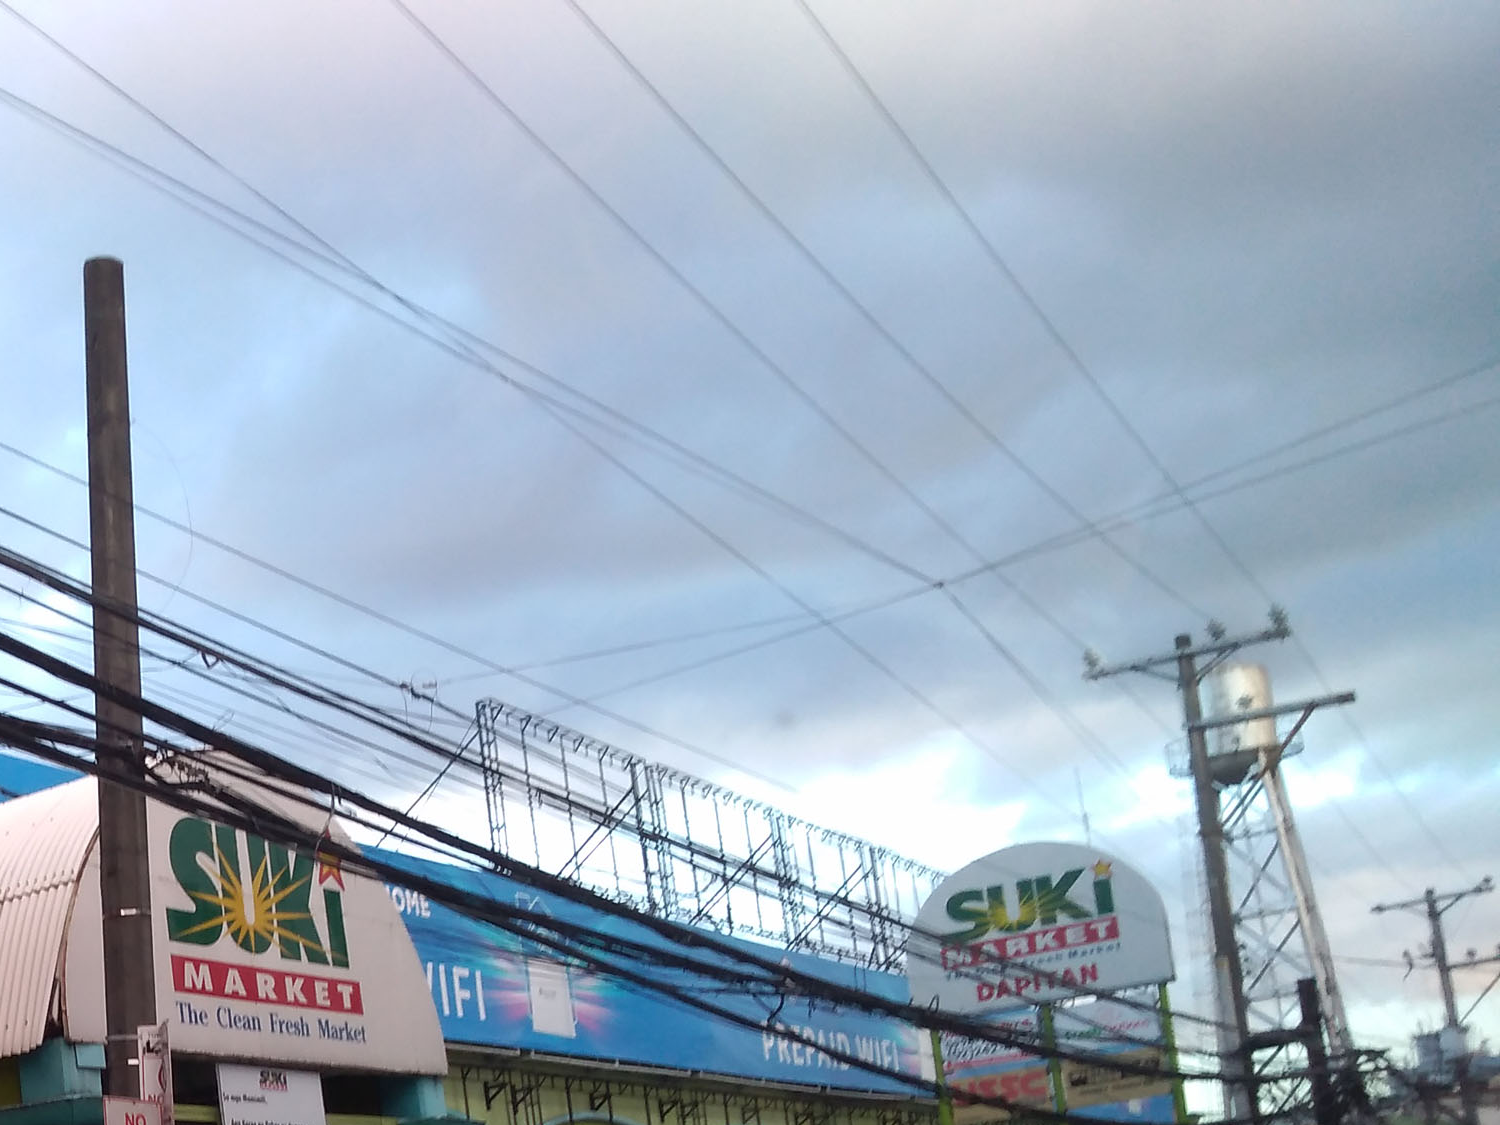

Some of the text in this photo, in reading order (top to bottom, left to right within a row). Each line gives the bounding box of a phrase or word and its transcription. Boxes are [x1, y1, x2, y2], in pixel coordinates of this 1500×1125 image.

[385, 883, 431, 919] OME
[945, 920, 1113, 967] MARKET
[183, 961, 354, 1010] MARKET
[977, 962, 1099, 1003] DAPITAN
[175, 1001, 367, 1044] The Clean Fresh Market
[761, 1020, 851, 1071] PREPAID
[855, 1033, 901, 1074] WIFI
